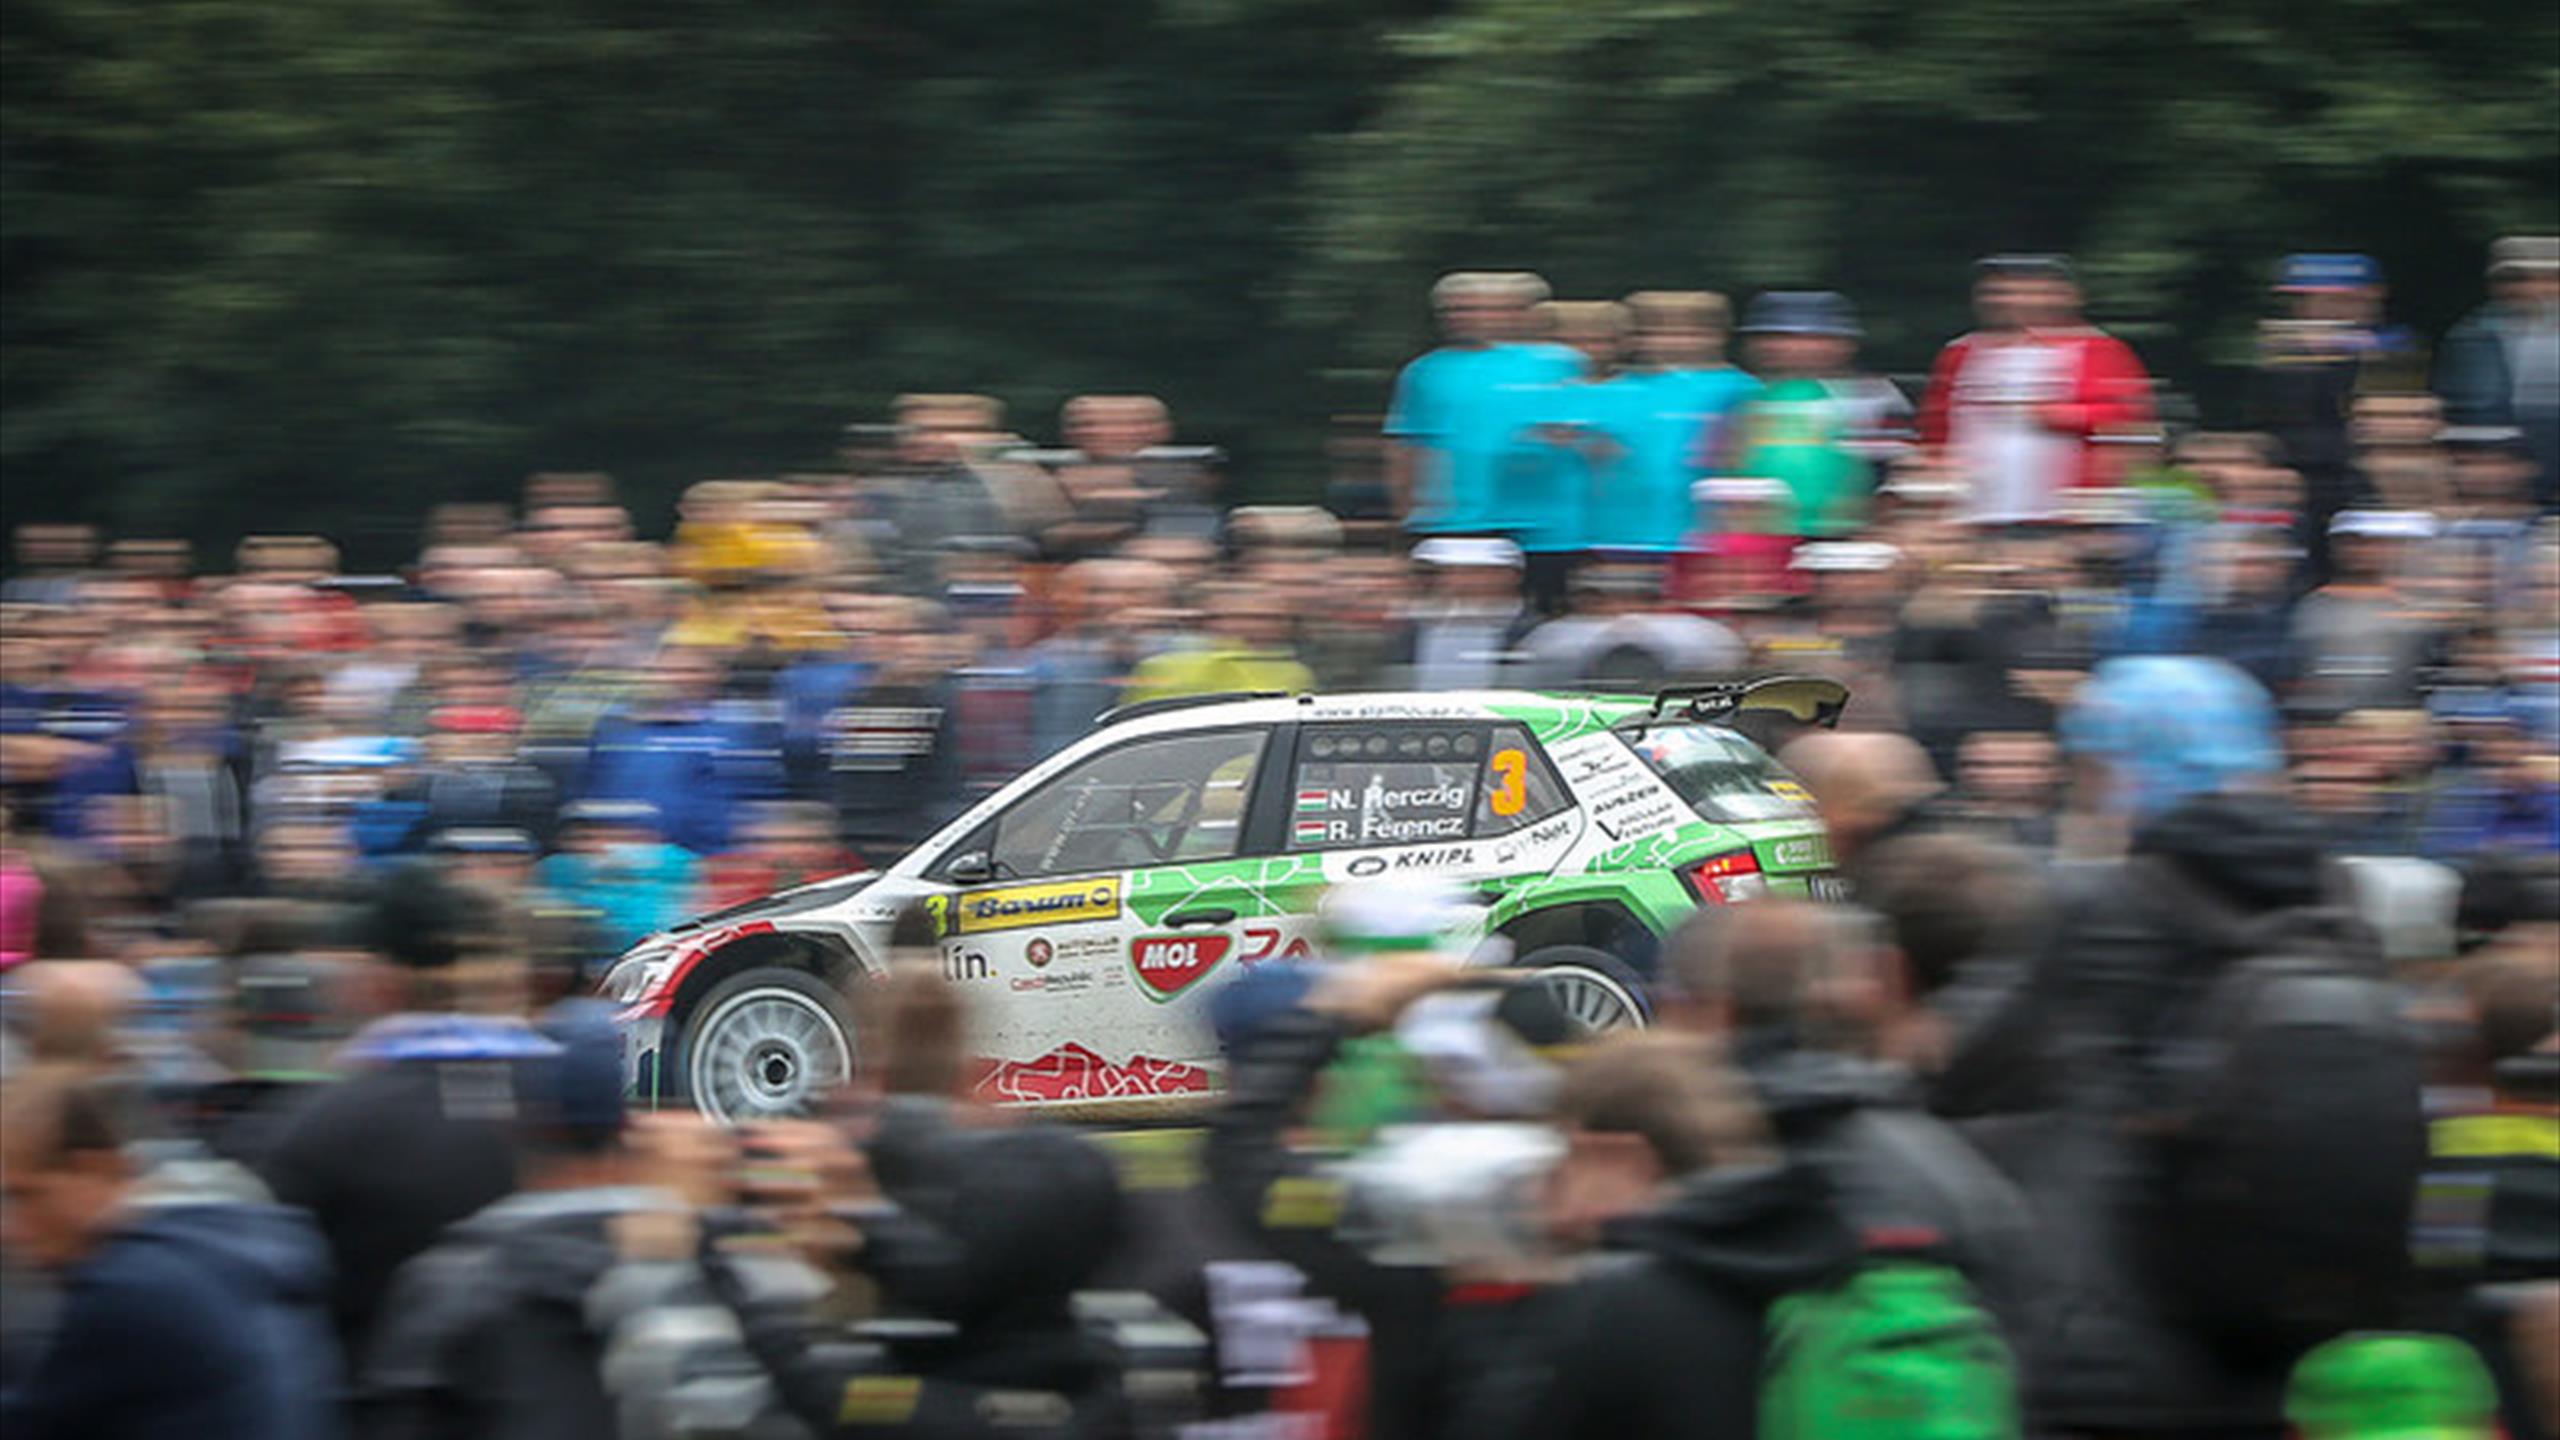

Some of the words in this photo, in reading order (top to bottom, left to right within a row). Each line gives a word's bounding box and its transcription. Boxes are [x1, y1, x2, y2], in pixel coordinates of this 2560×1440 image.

[1491, 748, 1528, 816] 3
[1330, 790, 1358, 810] N.
[1329, 820, 1356, 841] R.
[1362, 817, 1466, 839] Ferencz
[1395, 848, 1476, 868] KNIPL
[925, 894, 949, 937] 3
[976, 894, 1086, 919] Barum
[1140, 943, 1198, 970] MOL
